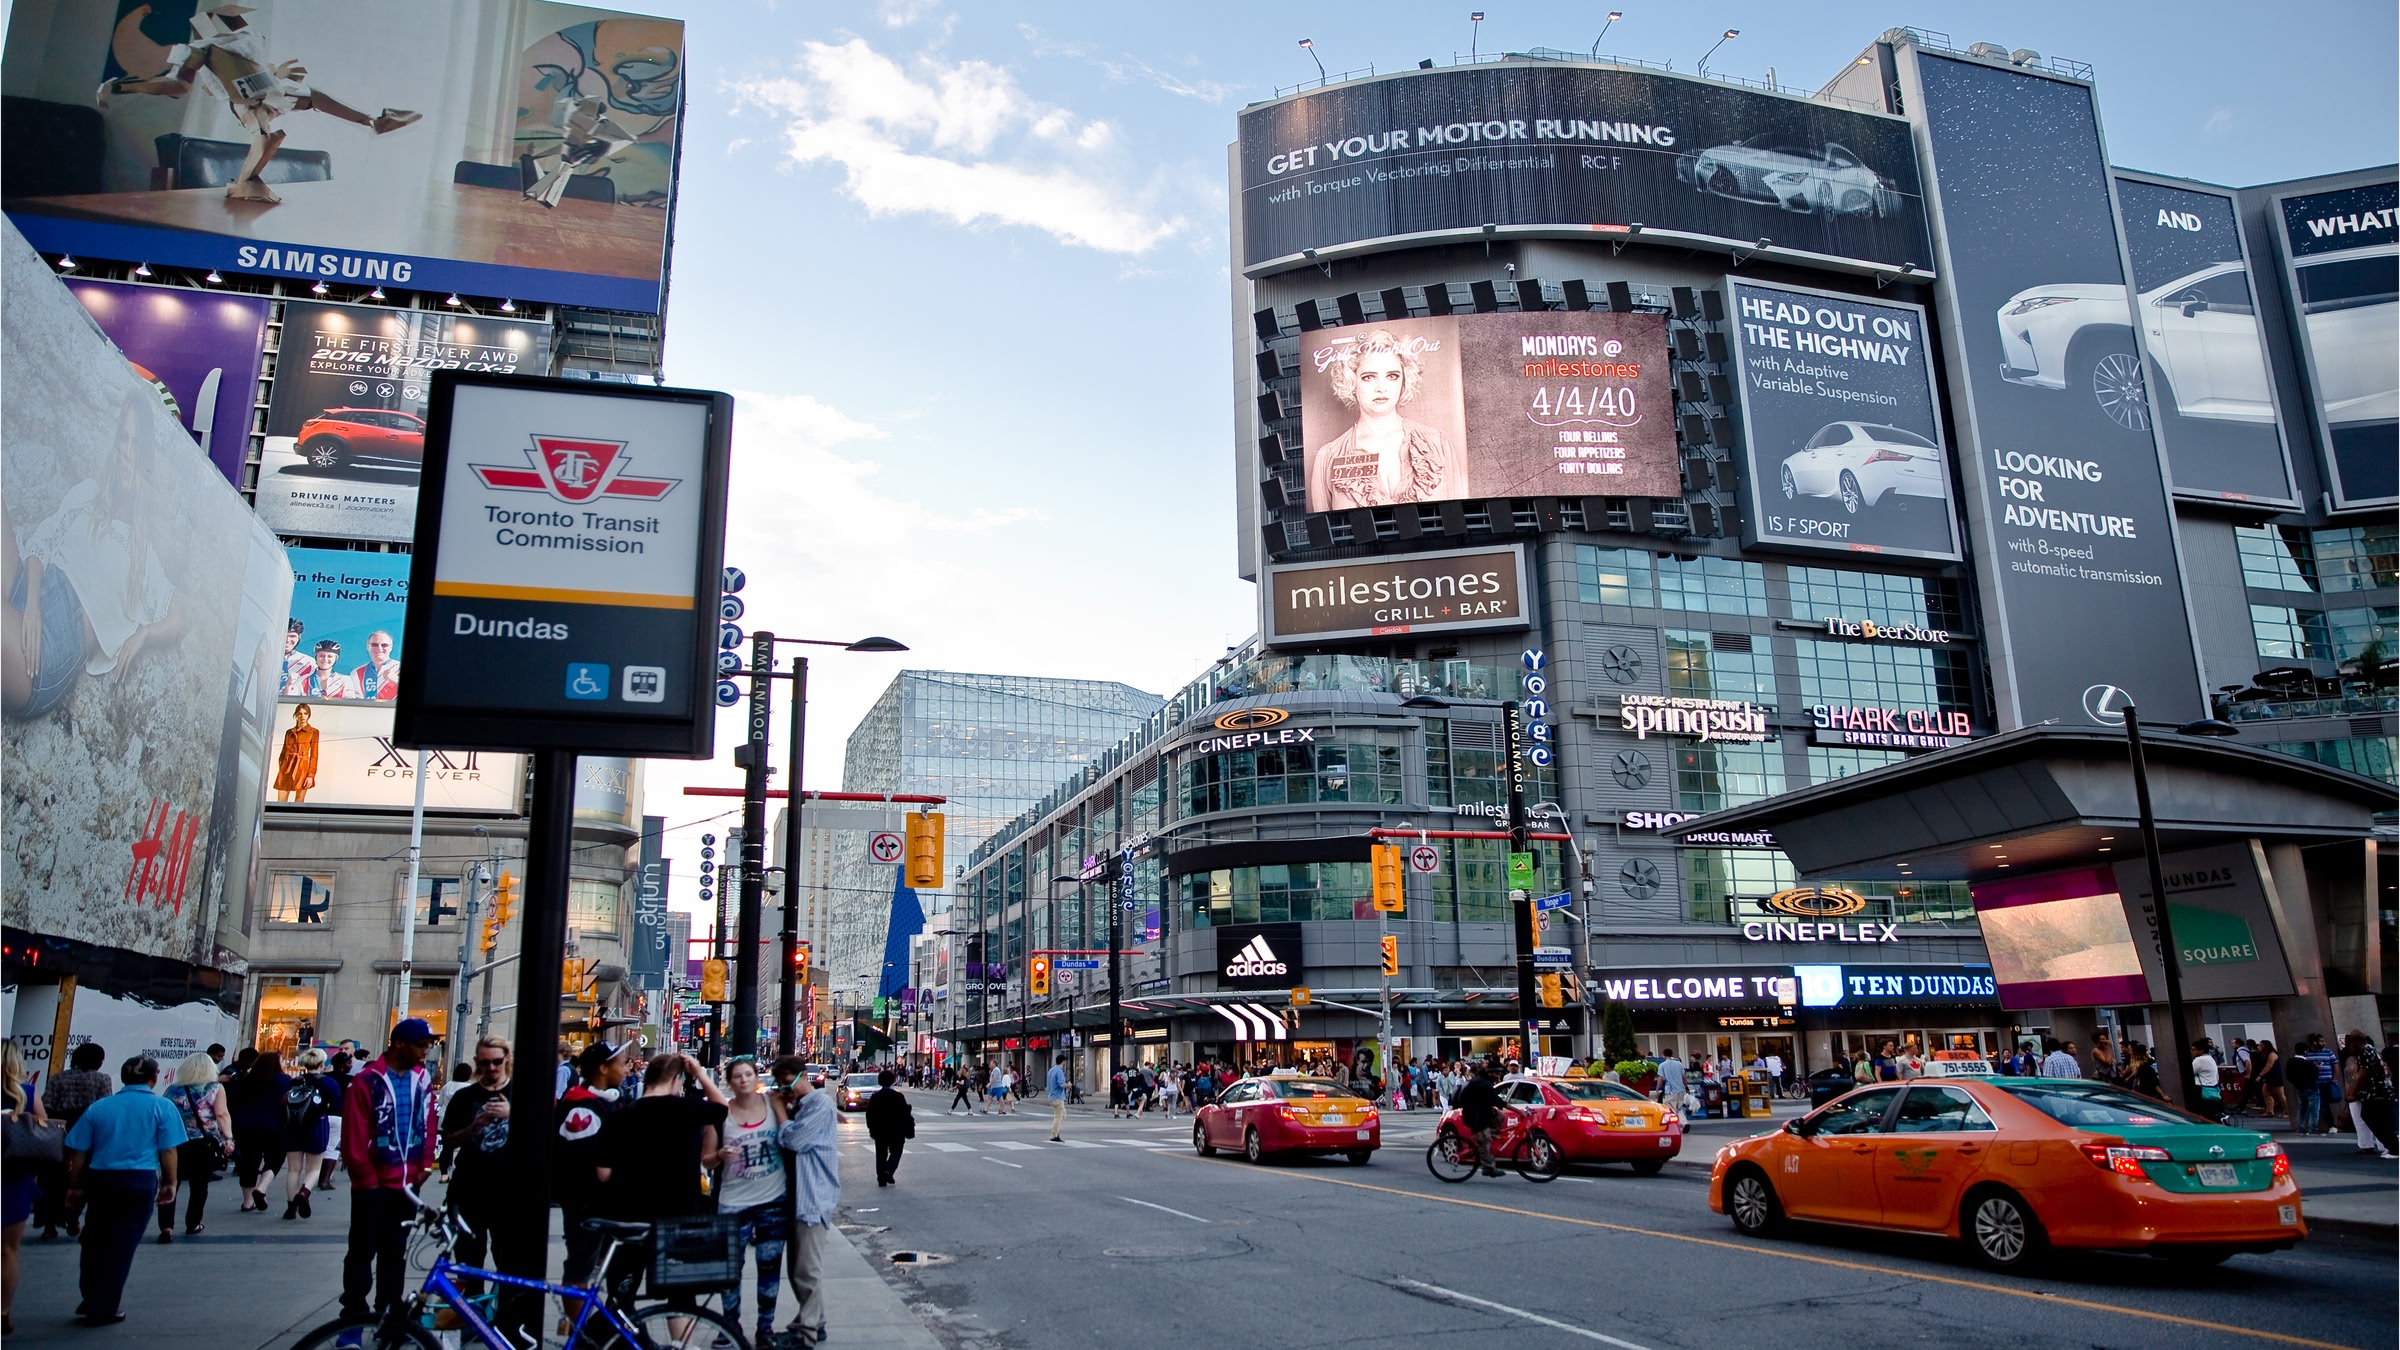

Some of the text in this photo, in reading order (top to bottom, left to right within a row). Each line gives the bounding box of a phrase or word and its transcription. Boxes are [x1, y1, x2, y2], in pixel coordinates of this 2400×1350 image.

[1267, 118, 1676, 175] GET YOUR MOTOR RUNNING
[1269, 154, 1621, 204] with Torque Vectoring Differential RC F
[2157, 209, 2202, 232] AND
[237, 245, 412, 283] SAMSUNG
[1742, 297, 1912, 341] HEAD OUT ON
[314, 336, 519, 363] THE FIRST-EVER AWD
[1522, 336, 1622, 357] MONDAYS @
[1744, 323, 1910, 366] THE HIGHWAY
[310, 361, 362, 372] EXPLORE
[368, 365, 399, 375] YOUR
[312, 348, 372, 361] 2016
[464, 361, 516, 374] CX-3
[1524, 358, 1640, 378] milestones
[1749, 356, 1849, 381] with Adaptive
[1751, 372, 1898, 406] Variable Suspension
[1532, 386, 1636, 417] 4/4/40
[1559, 431, 1618, 443] FOUR BELLINIS
[1554, 447, 1626, 459] FOUR APPETIZERS
[1334, 465, 1377, 479] 9753
[1559, 463, 1624, 475] FORTY DOLLARS
[1994, 449, 2102, 482] LOOKING
[291, 491, 396, 505] DRIVING MATTERS
[1999, 476, 2044, 502] FOR
[485, 506, 660, 534] Toronto Transit
[1769, 515, 1850, 538] IS F SPORT
[2004, 504, 2136, 539] ADVENTURE
[496, 528, 644, 554] Commission
[2008, 538, 2094, 560] with 8-speed
[312, 571, 335, 584] the
[340, 573, 393, 589] largest
[2011, 560, 2163, 585] automatic transmission
[317, 588, 330, 599] in
[336, 590, 379, 602] North
[1291, 570, 1500, 609] milestones
[1374, 605, 1435, 622] GRILL
[454, 612, 569, 642] Dundas
[1522, 648, 1551, 766] Yonge
[1621, 694, 1743, 711] LOUNGE RESTAURANT
[1813, 704, 1971, 736] SHARK CLUB
[1199, 728, 1315, 754] CINEPLEX
[1510, 709, 1524, 793] DOWNTOWN
[1844, 732, 1950, 748] SPORTS BAR GRILL
[367, 768, 481, 781] FOREVER
[1458, 801, 1550, 820] milestnes
[1688, 832, 1773, 843] DRUG MART
[125, 797, 199, 918] H&M
[636, 863, 661, 926] atrium
[1544, 898, 1559, 908] Yonge
[1744, 922, 1899, 942] CINEPLEX
[2183, 944, 2253, 963] SQUARE
[1226, 960, 1287, 977] adidas
[1604, 977, 1744, 1000] WELCOME
[1850, 976, 1902, 995] TEN
[1910, 975, 1994, 996] DUNDAS
[1729, 1018, 1754, 1026] Dundas
[20, 1035, 43, 1046] TO
[1948, 1052, 1971, 1060] BECK
[730, 1129, 778, 1146] ENICE BEAC
[742, 1140, 773, 1169] LA
[736, 1161, 779, 1180] CALIFORNI
